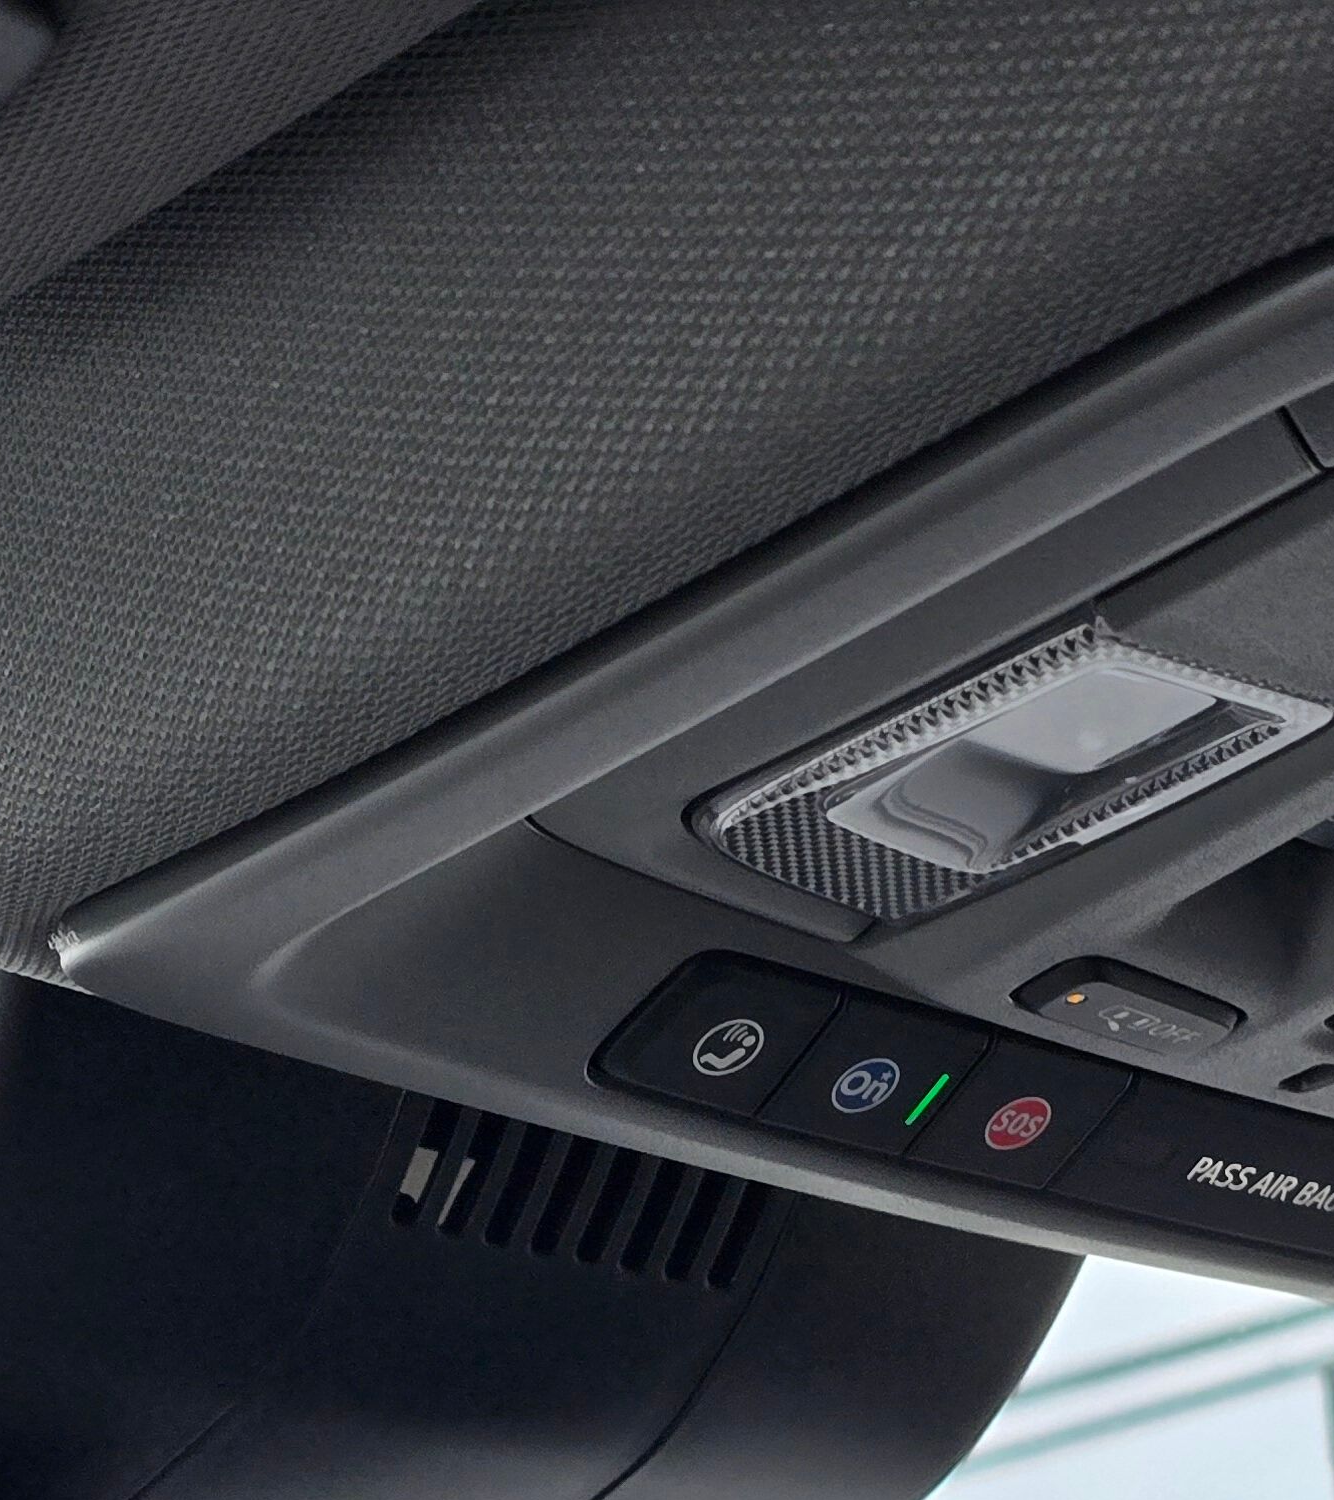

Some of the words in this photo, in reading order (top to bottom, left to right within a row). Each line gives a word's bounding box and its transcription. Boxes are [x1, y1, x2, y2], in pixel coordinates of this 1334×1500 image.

[840, 1070, 889, 1102] On
[992, 1109, 1044, 1138] SOS
[1186, 1156, 1257, 1191] PASS
[1248, 1171, 1298, 1202] AIR
